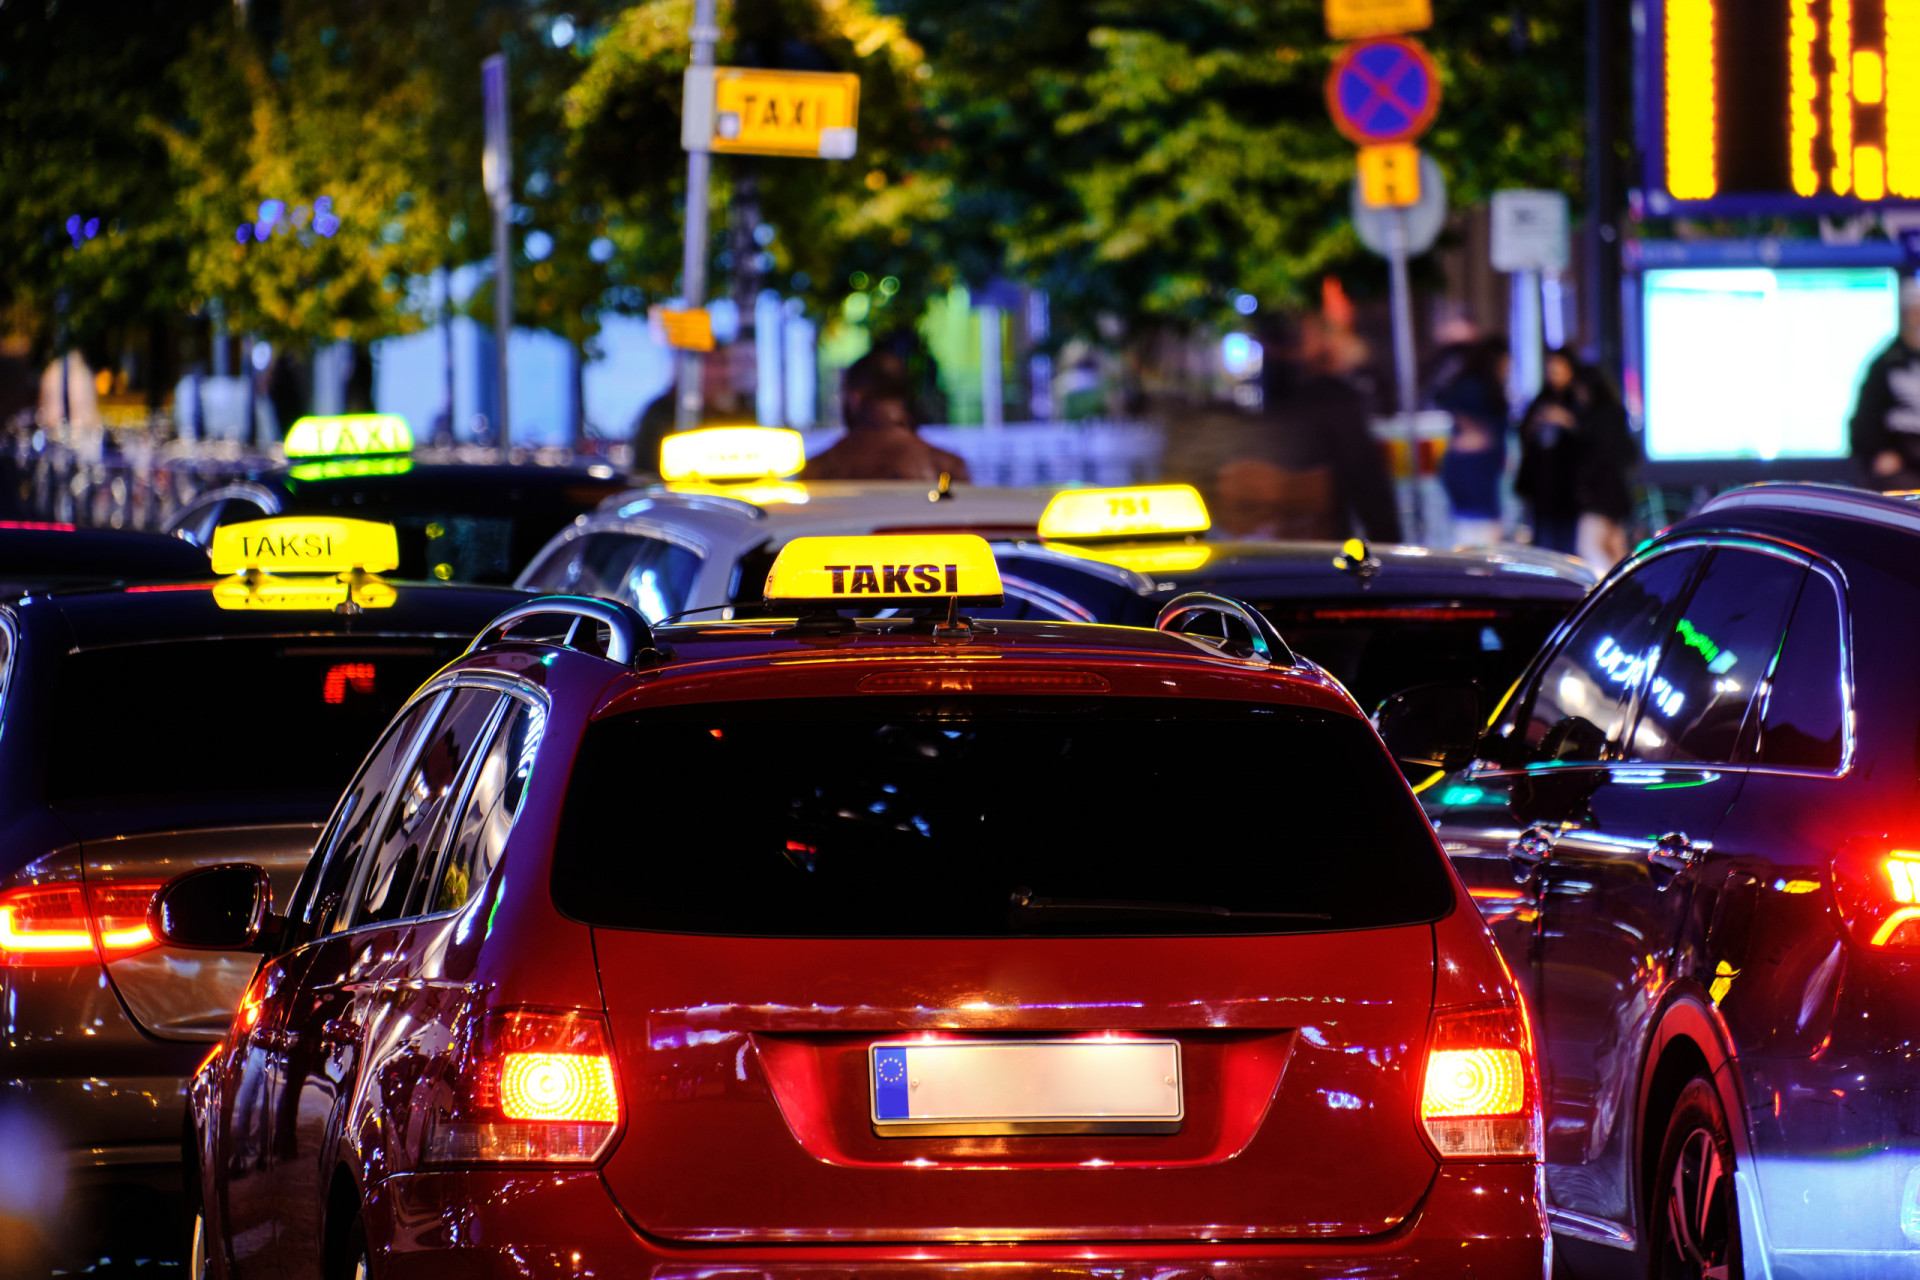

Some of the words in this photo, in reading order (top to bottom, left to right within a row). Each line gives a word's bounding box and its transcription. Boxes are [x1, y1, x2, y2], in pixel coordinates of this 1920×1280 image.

[741, 93, 827, 129] TAXI
[307, 418, 401, 455] TAXI
[241, 535, 333, 558] TAKSI
[823, 563, 959, 595] TAKSI
